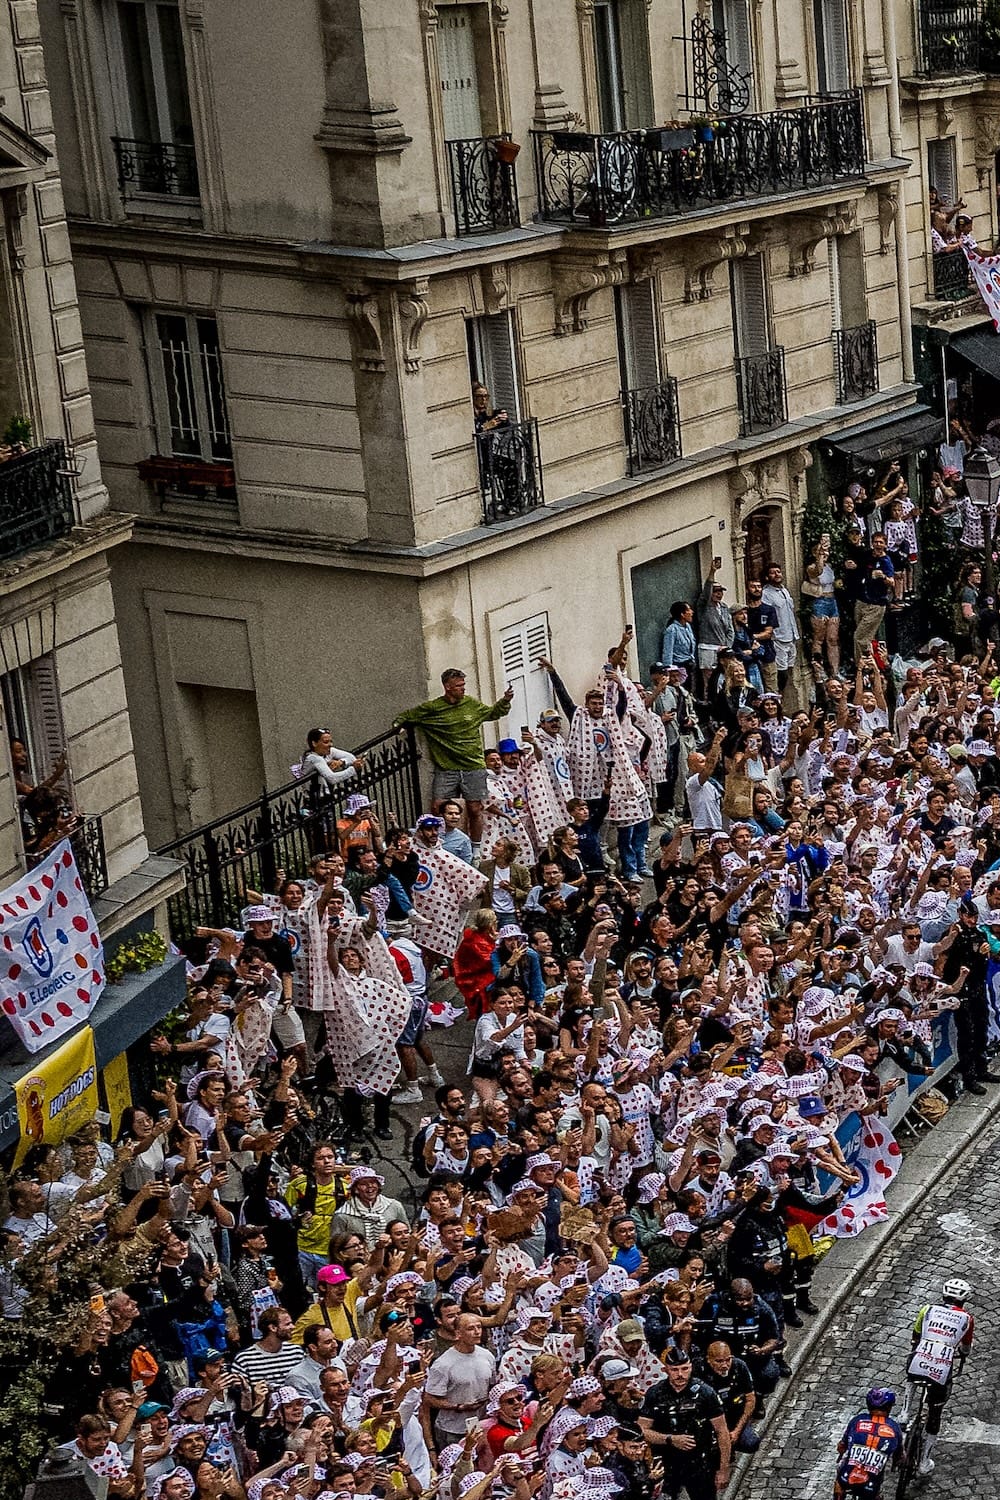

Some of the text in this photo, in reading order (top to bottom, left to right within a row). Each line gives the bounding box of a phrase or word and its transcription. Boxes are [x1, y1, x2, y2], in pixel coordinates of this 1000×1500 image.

[29, 971, 76, 1006] E.Leclerc
[49, 1064, 96, 1119] HOT DOGS
[921, 1341, 952, 1360] 41 41
[919, 1360, 944, 1375] Circus
